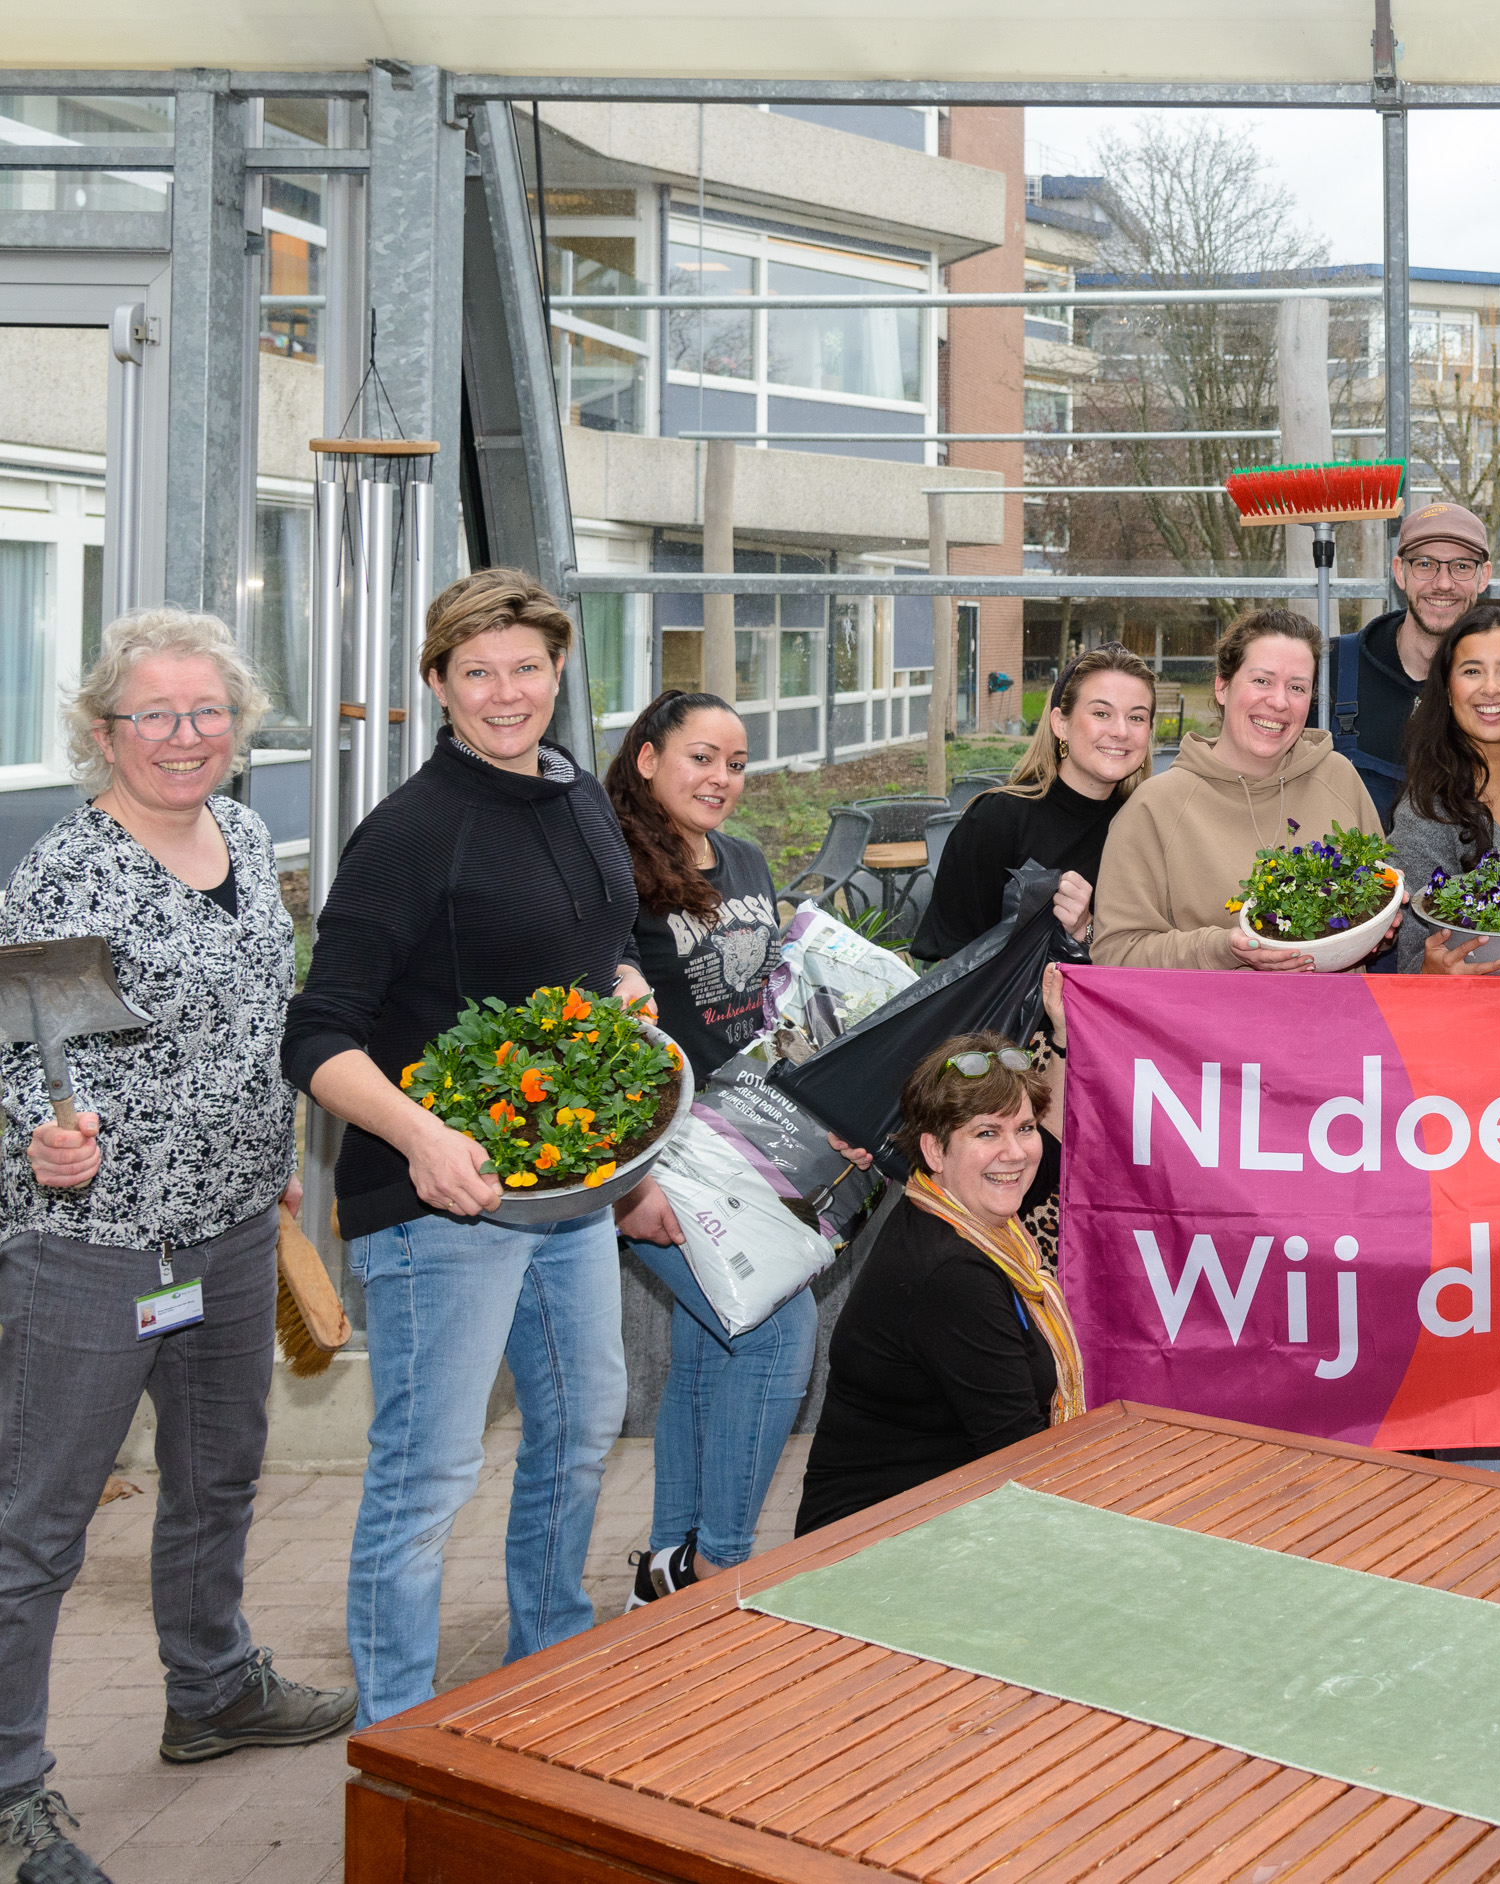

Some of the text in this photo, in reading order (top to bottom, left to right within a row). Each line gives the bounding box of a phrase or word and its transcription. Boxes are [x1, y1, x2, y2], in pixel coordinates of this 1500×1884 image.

[758, 1099, 783, 1122] POUR
[780, 1118, 799, 1135] POT
[695, 1211, 728, 1247] 40L
[1133, 1229, 1361, 1381] Wij
